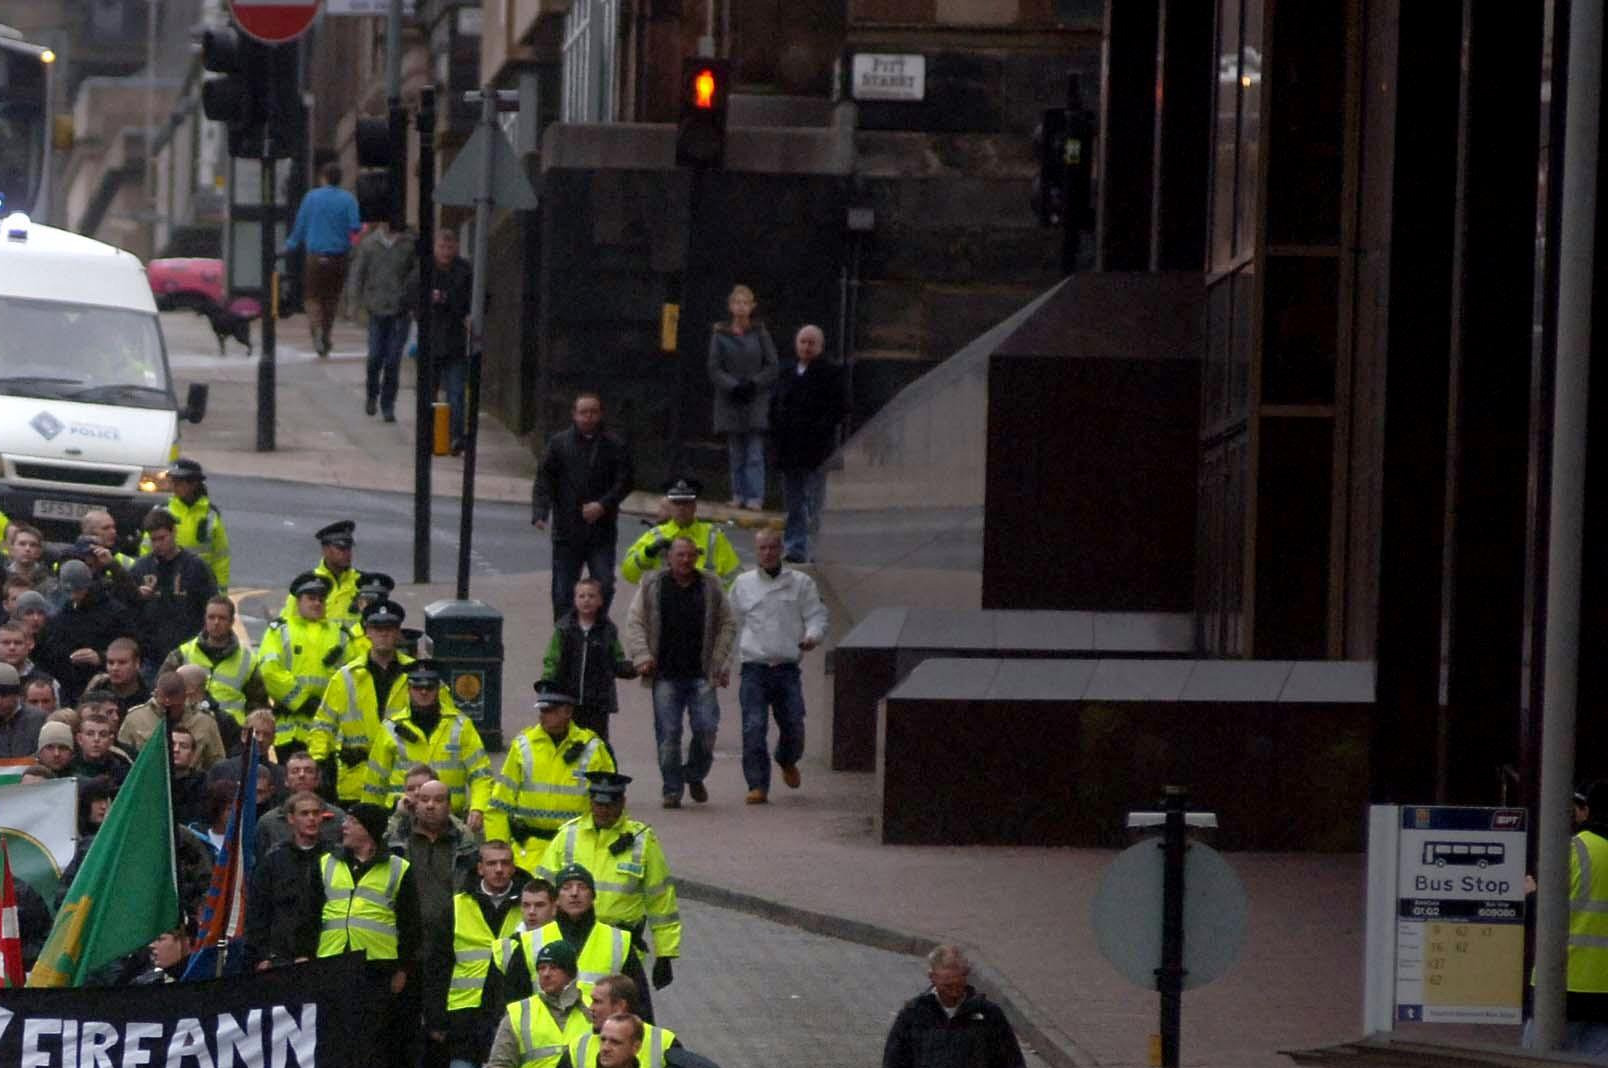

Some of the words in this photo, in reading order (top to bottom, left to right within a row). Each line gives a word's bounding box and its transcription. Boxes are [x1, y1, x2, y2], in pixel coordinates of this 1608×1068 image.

[71, 425, 120, 441] POLICE
[1415, 874, 1455, 892] Bus
[1460, 875, 1511, 896] Stop
